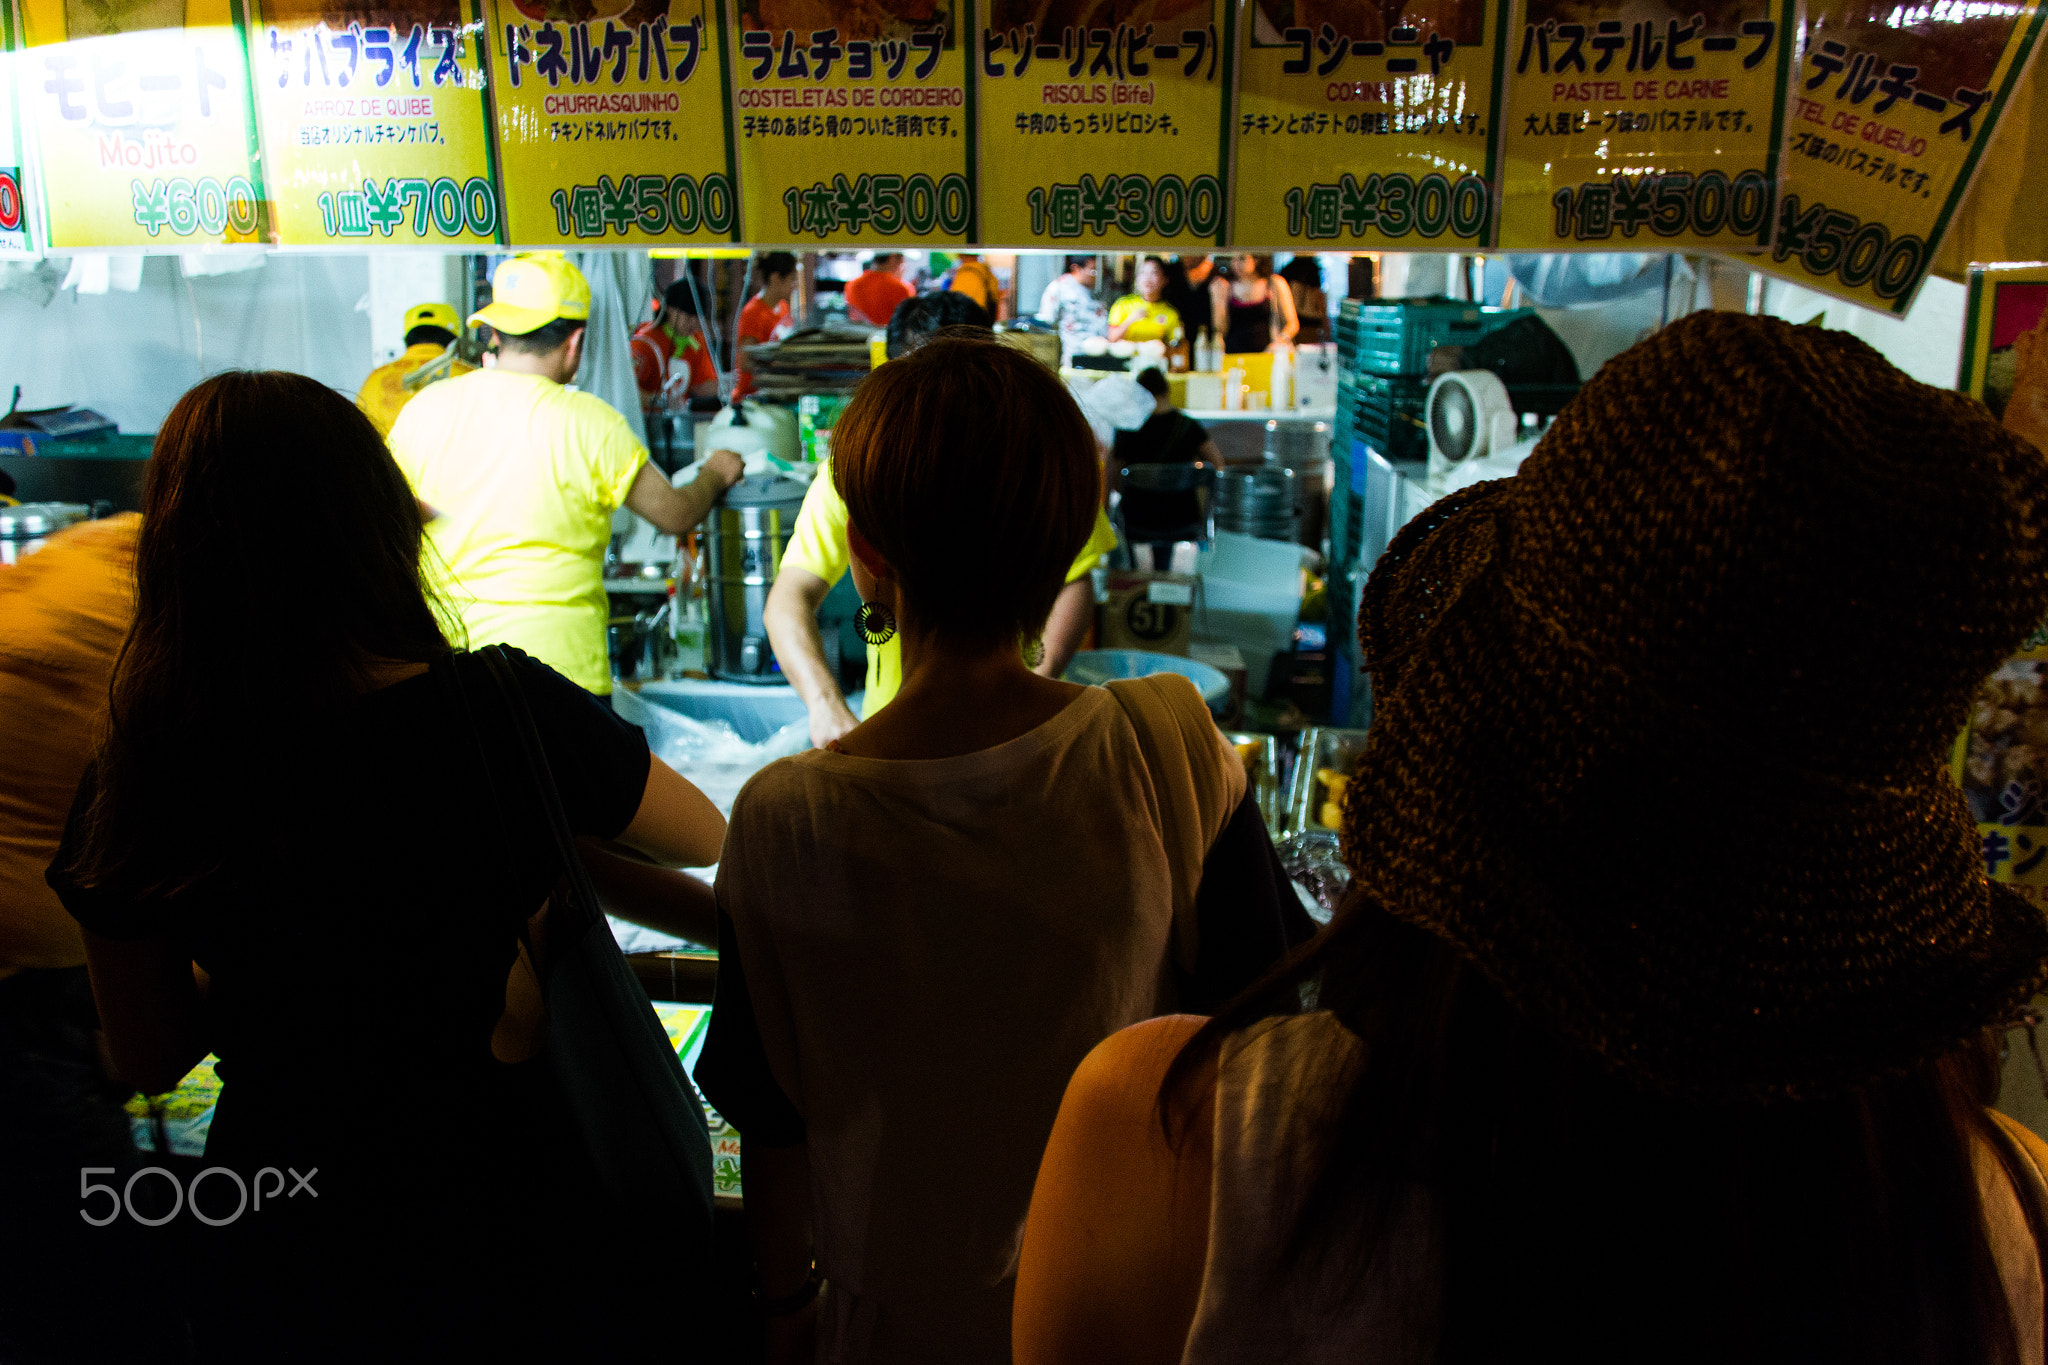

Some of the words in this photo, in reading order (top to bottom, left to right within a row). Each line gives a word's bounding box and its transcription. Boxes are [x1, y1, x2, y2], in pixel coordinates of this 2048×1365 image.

[505, 15, 703, 87] ドネルケバブ
[742, 26, 943, 82] ラムチョップ
[982, 23, 1217, 80] ヒゾーリス(ビーフ)
[1283, 26, 1454, 76] コシーニャ
[1517, 13, 1776, 75] パステルビーフ
[44, 46, 226, 121] モヒート
[305, 98, 354, 116] ARROZ
[361, 98, 382, 116] DE
[387, 98, 432, 116] QUIBE
[545, 93, 680, 115] CHURRASQUINHO
[739, 88, 848, 109] COSTELETAS
[853, 88, 876, 108] DE
[880, 87, 964, 108] CORDEIRO
[1042, 84, 1107, 104] RISOLIS
[1111, 82, 1155, 106] (Bife)
[1552, 81, 1626, 102] PASTEL
[1633, 80, 1659, 101] DE
[1664, 79, 1730, 100] CARNE
[1805, 36, 1993, 142] テルチーズ
[301, 122, 446, 146] 当店オリジナルチキンケバブ。
[551, 119, 678, 142] チキンドネルケバブです。
[743, 116, 958, 139] 子羊のあばら骨のついた背肉です。
[1015, 112, 1179, 136] 牛肉のもっちりピロシキ。
[1524, 108, 1754, 136] 大人気ビーフ味のパステルです。
[1831, 111, 1861, 136] DE
[99, 134, 197, 169] Mojito
[132, 176, 258, 237] ¥600
[318, 177, 497, 237] 1皿¥700
[552, 173, 735, 237] 1個¥500
[784, 173, 969, 237] 1本¥500
[1028, 173, 1222, 238] 1個¥300
[1285, 173, 1488, 238] 1個¥300
[1552, 169, 1769, 241] 1個¥500
[1132, 601, 1167, 633] 51
